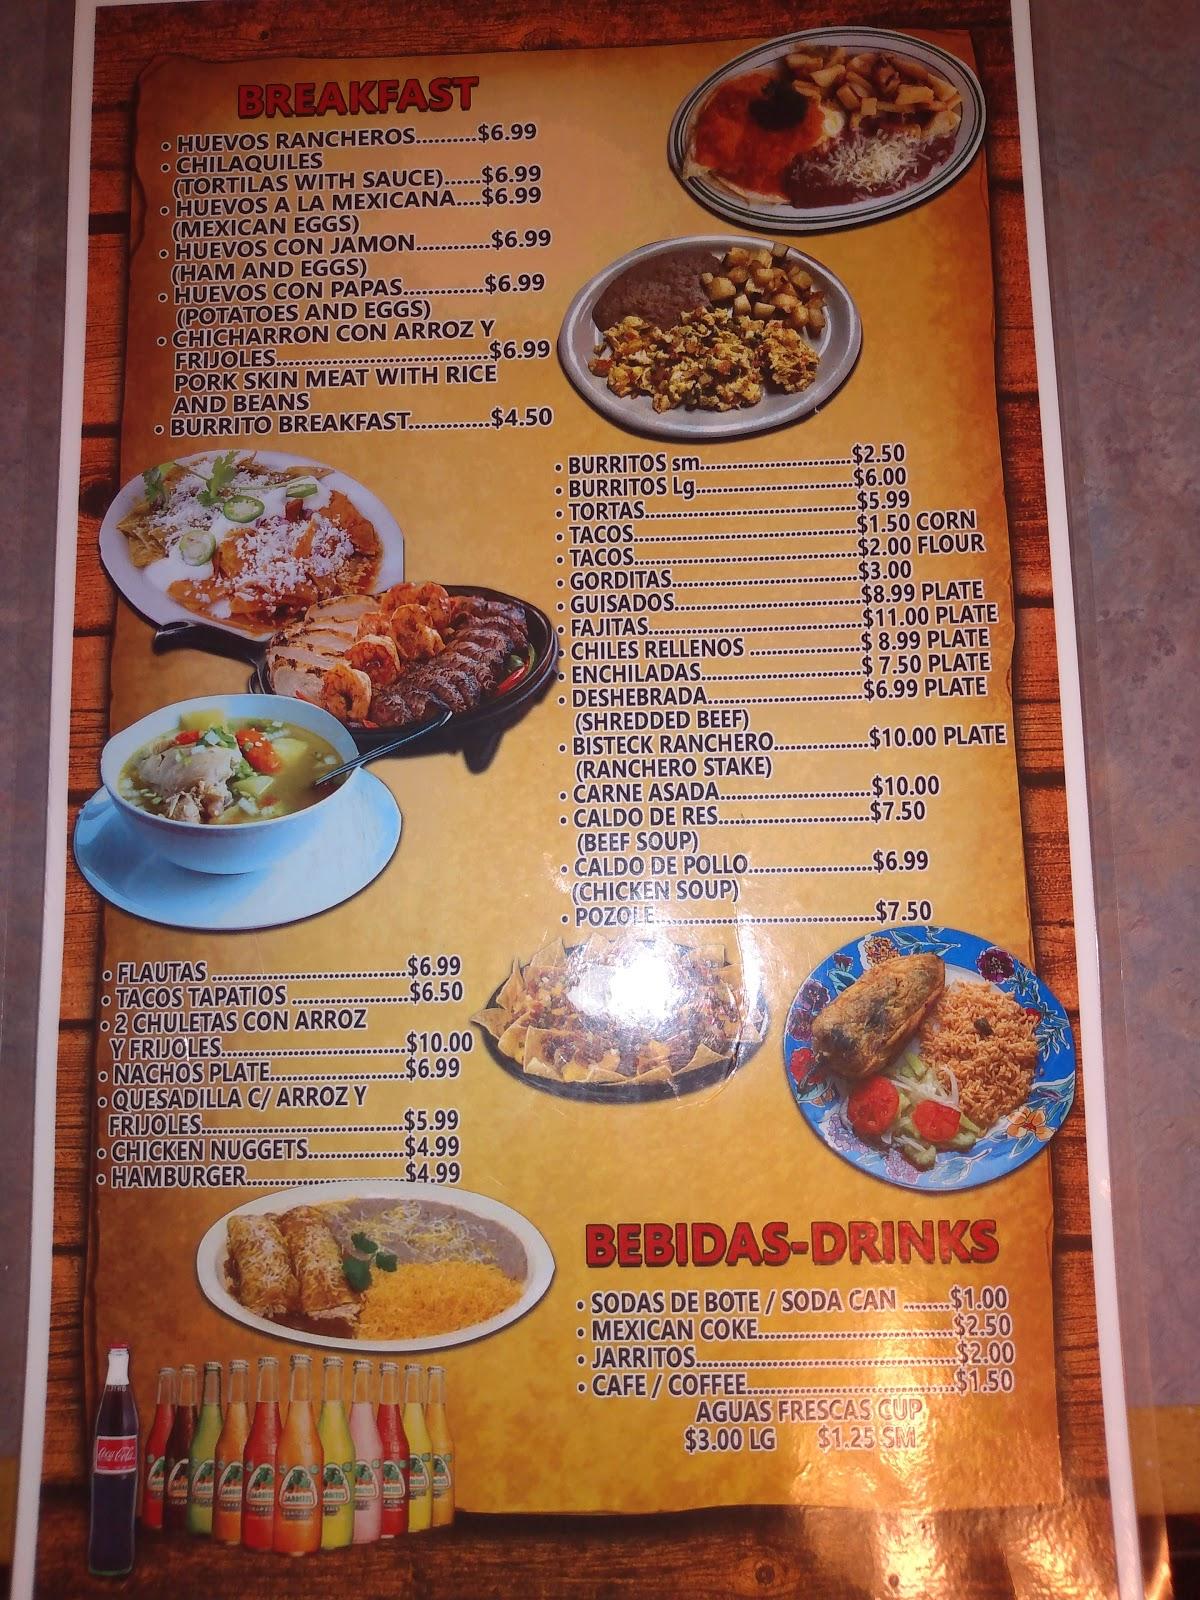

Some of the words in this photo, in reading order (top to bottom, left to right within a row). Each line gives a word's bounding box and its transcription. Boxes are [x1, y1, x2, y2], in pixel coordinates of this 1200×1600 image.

[238, 75, 479, 119] BREAKFAST
[176, 133, 270, 153] HUEVOS
[275, 127, 416, 149] RANCHEROS
[478, 123, 537, 143] $6.99
[175, 153, 323, 174] CHILAQUILES
[172, 176, 289, 198] (TORTILAS
[294, 173, 356, 191] WITH
[363, 168, 444, 189] SAUCE)
[481, 164, 542, 185] $6.99
[175, 196, 268, 217] HUEVOS
[273, 195, 291, 213] A
[297, 194, 325, 213] LA
[331, 189, 456, 211] MEXICANA
[481, 186, 542, 206] $6.99
[172, 218, 288, 241] (MEXICAN
[293, 214, 360, 235] EGGS)
[175, 239, 268, 260] HUEVOS
[273, 238, 323, 257] CON
[329, 234, 416, 255] JAMON
[491, 229, 552, 250] $6.99
[171, 263, 235, 285] (HAM
[242, 261, 294, 279] AND
[300, 257, 368, 279] EGGS)
[174, 283, 267, 304] HUEVOS
[273, 281, 324, 300] CON
[331, 278, 403, 298] PAPAS
[484, 273, 545, 294] $6.99
[176, 304, 299, 328] (POTATOES
[305, 303, 358, 321] AND
[364, 299, 432, 320] EGGS)
[172, 325, 329, 349] CHICHARRON
[336, 323, 388, 344] CON
[394, 320, 473, 340] ARROZ
[480, 319, 495, 338] Y
[175, 349, 276, 370] FRIJOLES
[489, 340, 551, 361] $6.99
[175, 372, 237, 391] PORK
[243, 371, 298, 390] SKIN
[305, 369, 368, 387] MEAT
[375, 367, 439, 384] WITH
[446, 364, 497, 384] RICE
[173, 395, 226, 415] AND
[233, 393, 309, 413] BEANS
[171, 414, 272, 436] BURRITO
[279, 411, 411, 433] BREAKFAST
[491, 407, 552, 430] $4.50
[569, 454, 666, 475] BURRITOS
[672, 456, 700, 472] sm
[852, 444, 905, 465] $2.50
[569, 477, 667, 498] BURRITOS
[673, 477, 695, 499] Lg
[853, 467, 906, 488] $6.00
[569, 501, 644, 521] TORTAS
[857, 490, 910, 512] $5.99
[569, 524, 633, 544] TACOS
[857, 513, 910, 535] $1.50
[916, 510, 976, 530] CORN
[570, 548, 634, 567] TACOS
[858, 537, 911, 558] $2.00
[918, 534, 985, 554] FLOUR
[570, 570, 672, 590] GORDITAS
[858, 560, 912, 582] $3.00
[570, 593, 674, 613] GUISADOS
[861, 584, 915, 605] $8.99
[922, 581, 983, 601] PLATE
[571, 617, 649, 637] FAJITAS
[863, 607, 929, 629] $11.00
[936, 604, 998, 624] PLATE
[571, 641, 639, 660] CHILES
[645, 638, 744, 659] RELLENOS
[927, 628, 989, 648] PLATE
[573, 663, 700, 684] ENCHILADAS
[928, 652, 990, 673] PLATE
[573, 687, 707, 708] DESHEBRADA
[863, 679, 918, 701] $6.99
[925, 677, 987, 697] PLATE
[575, 711, 690, 734] (SHREDDED
[697, 709, 749, 730] BEEF)
[573, 735, 653, 755] BISTECK
[661, 732, 773, 754] RANCHERO
[870, 727, 936, 749] $10.00
[944, 725, 1006, 745] PLATE
[576, 759, 697, 782] (RANCHERO
[703, 757, 772, 778] STAKE)
[573, 783, 642, 804] CARNE
[648, 782, 720, 802] ASADA
[872, 775, 940, 798] $10.00
[574, 808, 643, 828] CALDO
[650, 807, 676, 826] DE
[683, 806, 718, 826] RES
[870, 800, 926, 823] $7.50
[578, 833, 630, 855] (BEEF
[636, 831, 698, 853] SOUP)
[575, 857, 644, 877] CALDO
[652, 856, 677, 876] DE
[684, 854, 748, 874] POLLO
[873, 849, 929, 873] $6.99
[572, 881, 669, 904] (CHICKEN
[677, 880, 739, 902] SOUP)
[576, 906, 654, 927] POZOLE
[876, 900, 932, 923] $7.50
[117, 961, 207, 983] FLAUTAS
[407, 956, 461, 977] $6.99
[116, 988, 181, 1008] TACOS
[188, 985, 286, 1007] TAPATIOS
[410, 980, 463, 1002] $6.50
[114, 1014, 127, 1033] 2
[133, 1011, 237, 1033] CHULETAS
[243, 1011, 289, 1031] CON
[294, 1009, 367, 1030] ARROZ
[110, 1040, 124, 1059] Y
[130, 1036, 222, 1059] FRIJOLES
[406, 1032, 473, 1054] $10.00
[114, 1062, 204, 1084] NACHOS
[209, 1062, 270, 1082] PLATE
[405, 1057, 460, 1079] $6.99
[112, 1086, 243, 1112] QUESADILLA
[248, 1086, 270, 1110] C/
[276, 1086, 349, 1107] ARROZ
[353, 1086, 367, 1105] Y
[109, 1114, 201, 1137] FRIJOLES
[404, 1109, 459, 1131] $5.99
[112, 1141, 204, 1161] CHICKEN
[210, 1139, 308, 1160] NUGGETS
[404, 1135, 460, 1158] $4.99
[112, 1164, 246, 1187] HAMBURGER
[405, 1162, 461, 1183] $4.99
[585, 1219, 1000, 1268] BEBIDAS-DRINKS
[591, 1292, 665, 1313] SODAS
[671, 1292, 699, 1312] DE
[706, 1291, 759, 1312] BOTE
[765, 1291, 776, 1315] /
[782, 1289, 842, 1312] SODA
[850, 1289, 896, 1311] CAN
[951, 1286, 1007, 1311] $1.00
[593, 1320, 693, 1341] MEXICAN
[700, 1318, 757, 1340] COKE
[954, 1313, 1011, 1338] $2.50
[592, 1347, 695, 1368] JARRITOS
[957, 1341, 1014, 1366] $2.00
[593, 1374, 645, 1395] CAFE
[651, 1375, 662, 1398] /
[668, 1374, 746, 1395] COFFEE
[957, 1368, 1012, 1393] $1.50
[696, 1400, 771, 1423] AGUAS
[778, 1399, 871, 1422] FRESCAS
[878, 1399, 923, 1420] CUP
[685, 1427, 742, 1452] $3.00
[750, 1429, 775, 1450] LG
[819, 1425, 874, 1451] $1.25
[883, 1426, 916, 1449] SM
